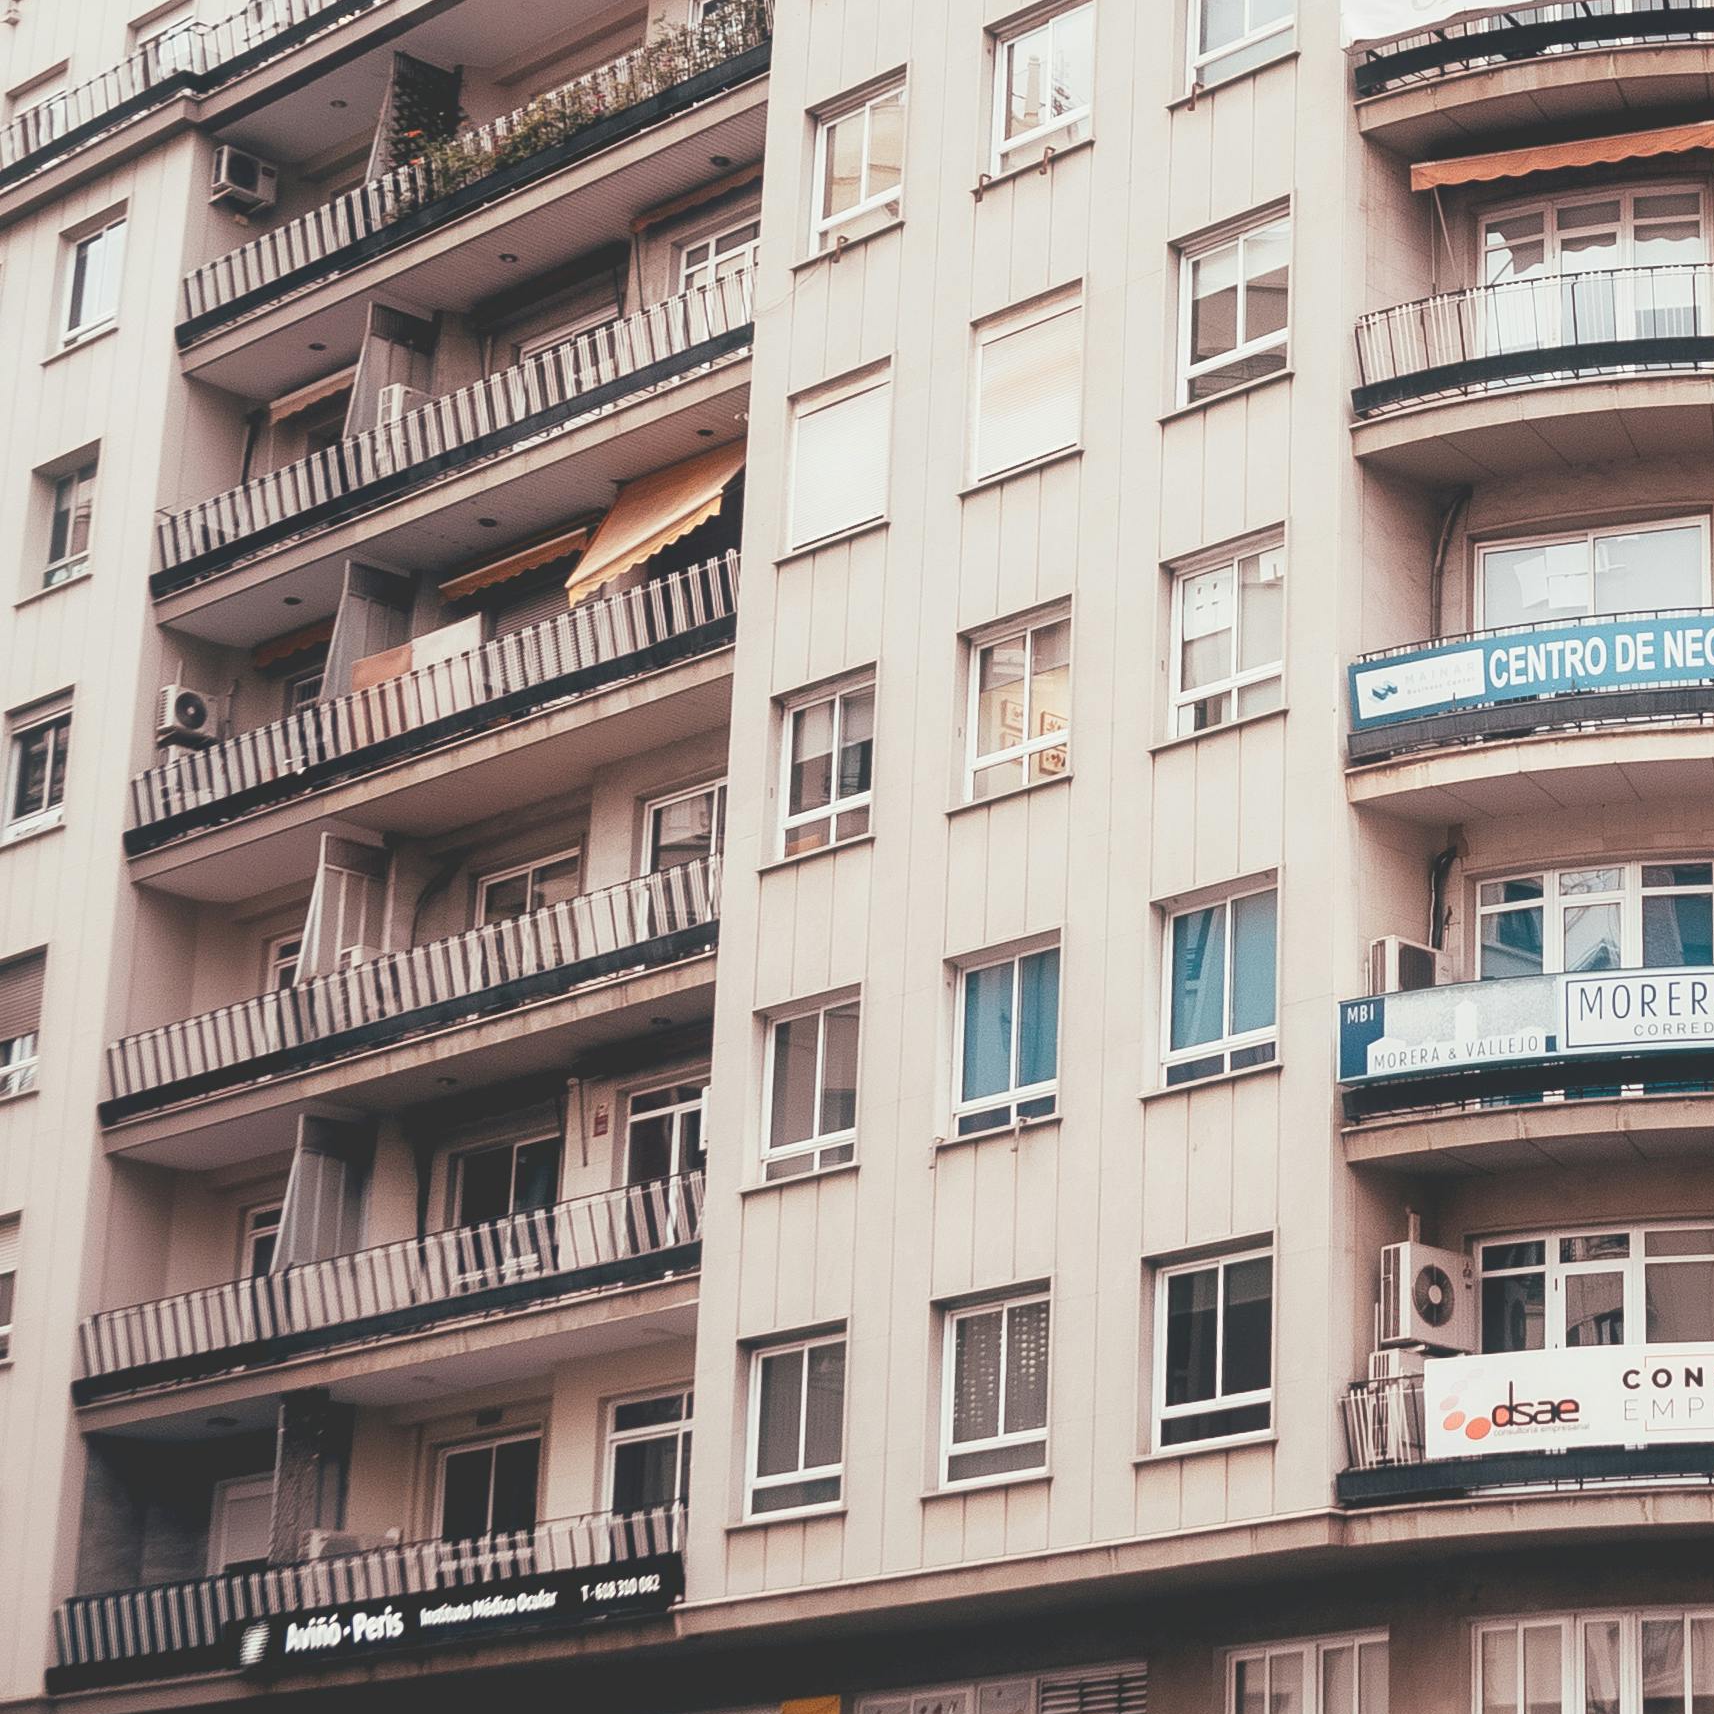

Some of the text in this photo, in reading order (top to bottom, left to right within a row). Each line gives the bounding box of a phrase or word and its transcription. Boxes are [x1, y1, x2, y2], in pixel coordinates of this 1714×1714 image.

[1404, 661, 1476, 684] MAINAR
[1488, 636, 1608, 688] CENTRO
[1615, 632, 1656, 673] DE
[1346, 1003, 1375, 1024] MBI
[1374, 1035, 1539, 1071] MORERA & VALLEJO
[1491, 1380, 1580, 1428] dsae
[516, 1588, 559, 1613] Ocular
